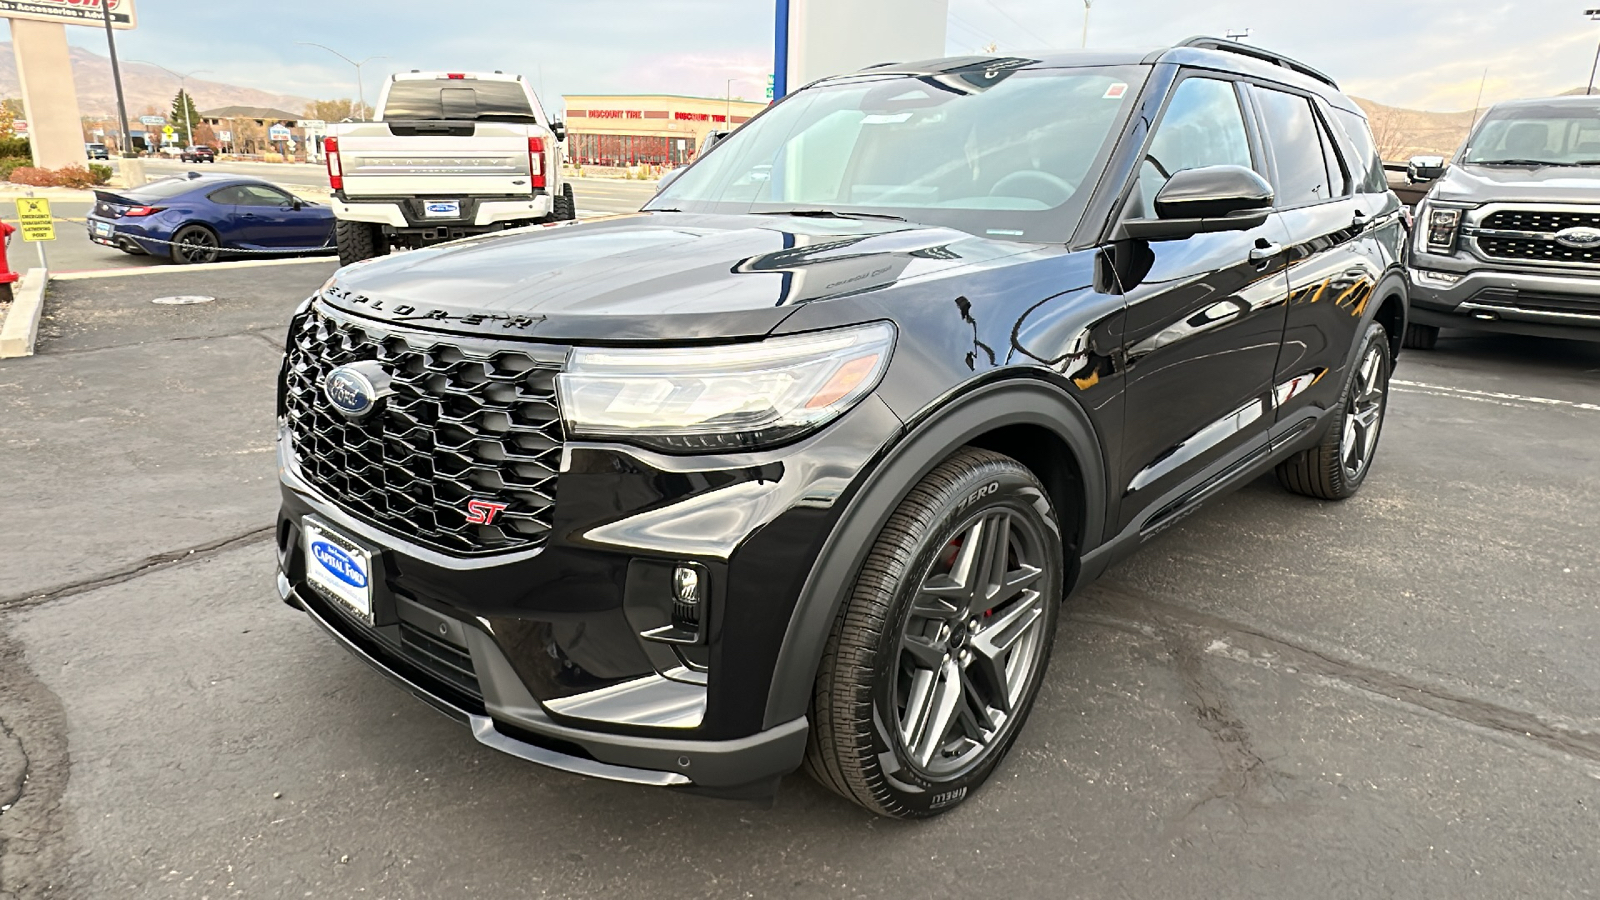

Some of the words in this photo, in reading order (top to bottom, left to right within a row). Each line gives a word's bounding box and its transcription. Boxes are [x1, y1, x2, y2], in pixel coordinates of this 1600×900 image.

[17, 3, 77, 16] Accessories
[84, 11, 116, 21] Advie
[588, 109, 624, 118] DISCOUNT
[625, 110, 642, 119] TIRE
[674, 111, 710, 121] DISCOUNT
[711, 114, 727, 123] TIRE
[326, 286, 533, 329] EXPLORER
[331, 376, 360, 407] Ford
[957, 481, 999, 516] ZERO
[465, 498, 508, 525] ST
[931, 786, 968, 804] PIRELLI
